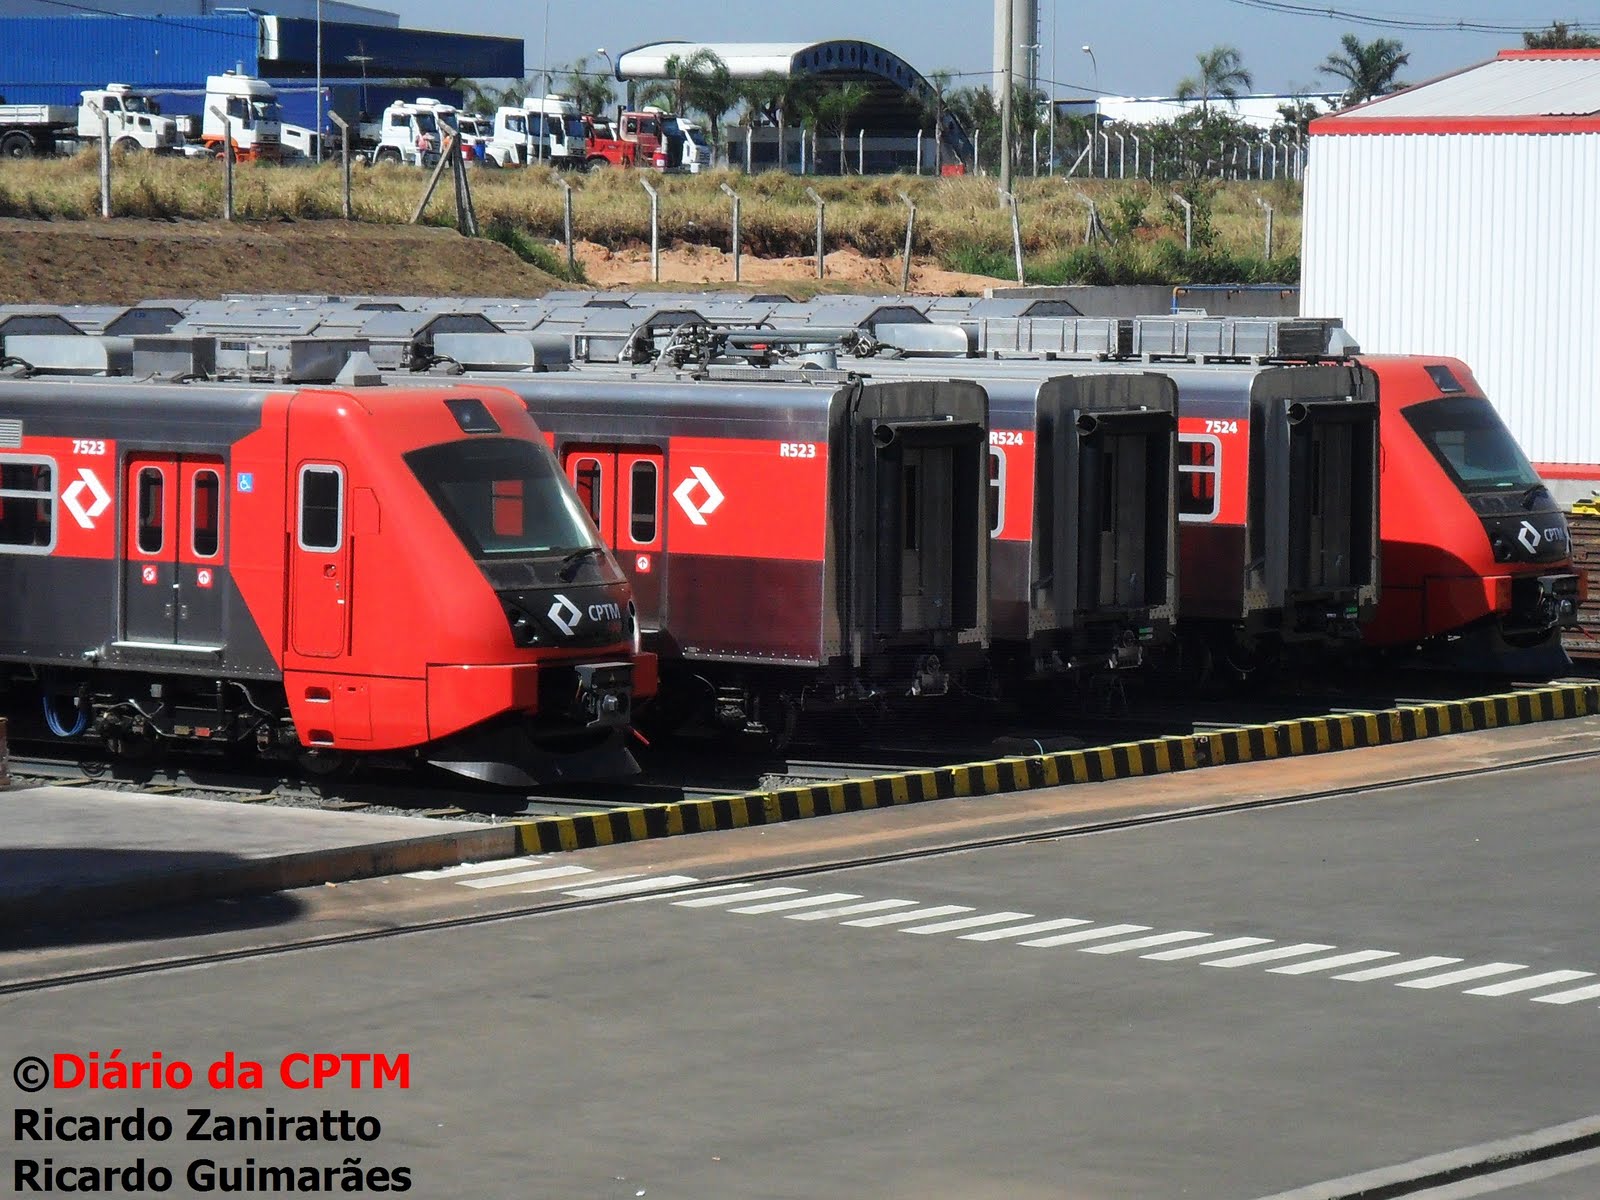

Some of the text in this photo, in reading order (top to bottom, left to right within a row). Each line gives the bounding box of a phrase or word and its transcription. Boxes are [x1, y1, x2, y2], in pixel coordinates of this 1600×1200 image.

[1205, 420, 1238, 433] 7524
[989, 431, 1023, 445] R524
[72, 440, 105, 455] 7523
[780, 443, 816, 458] R523
[1543, 527, 1564, 542] CPTM
[588, 603, 621, 621] CPTM
